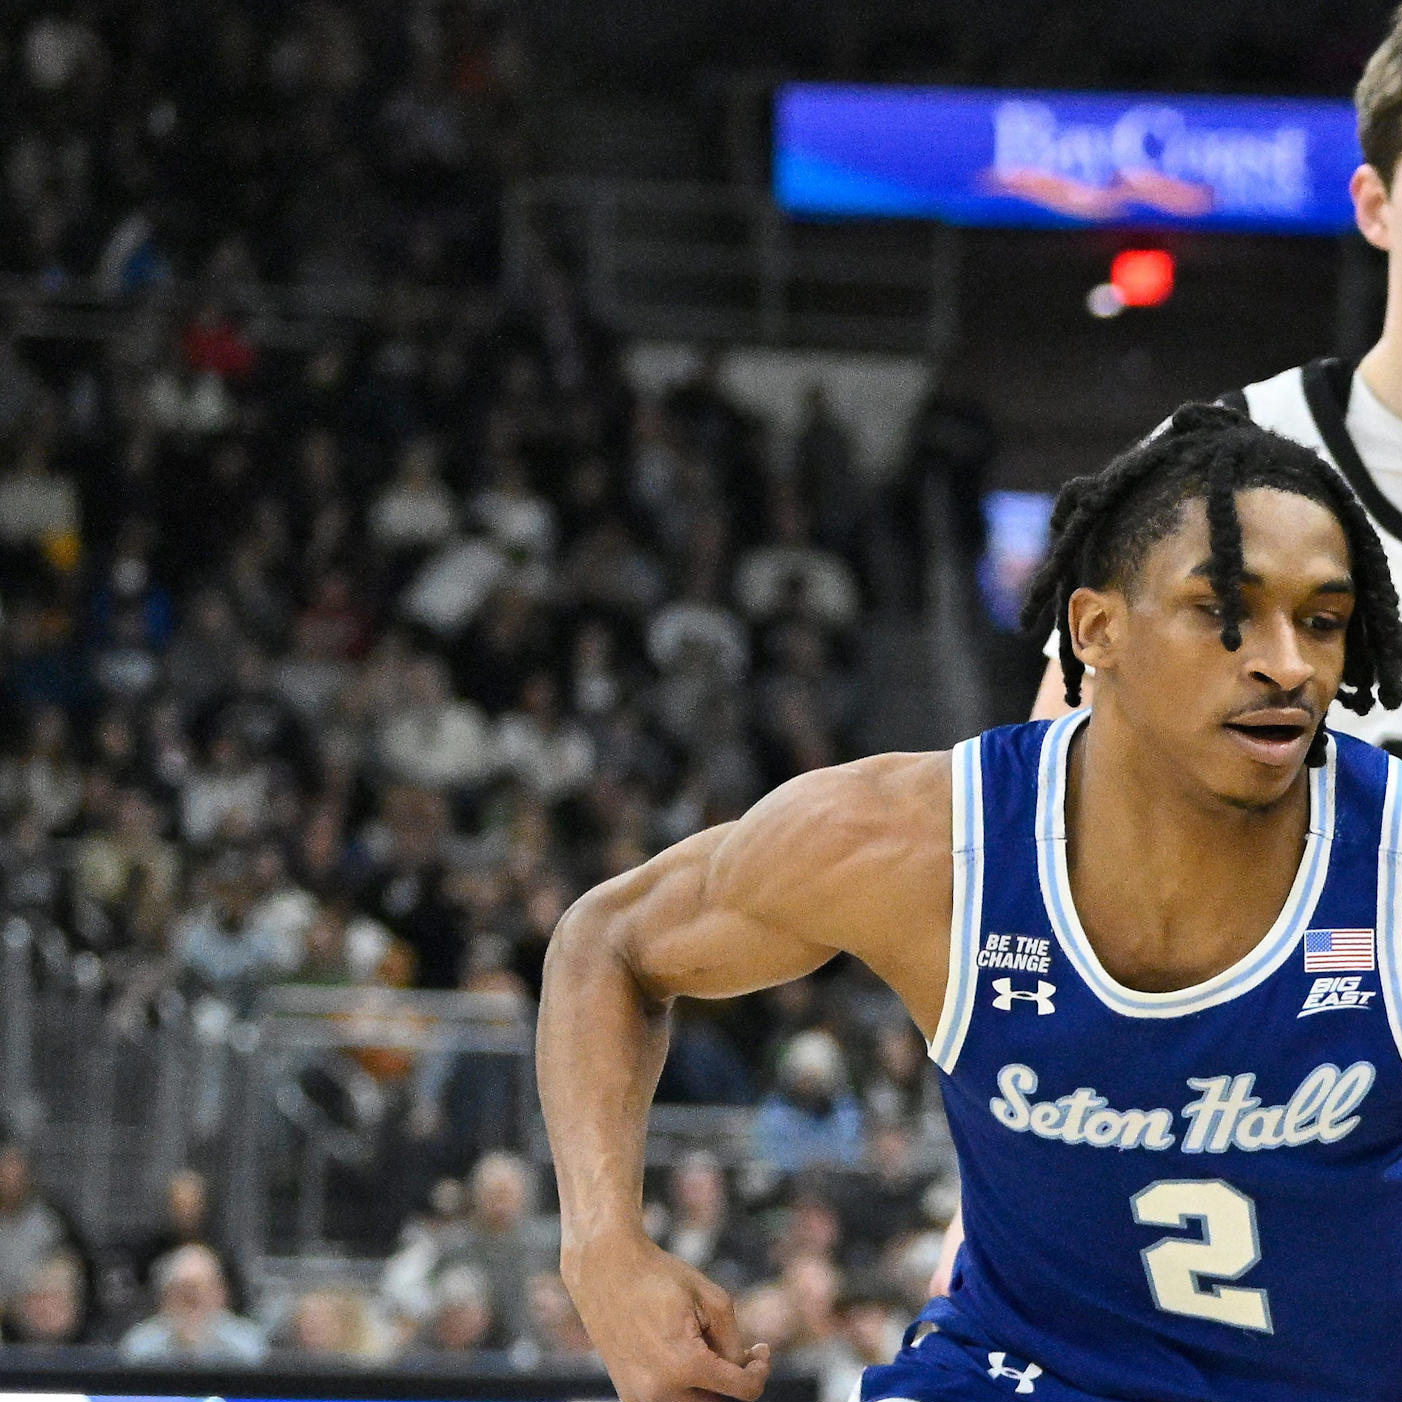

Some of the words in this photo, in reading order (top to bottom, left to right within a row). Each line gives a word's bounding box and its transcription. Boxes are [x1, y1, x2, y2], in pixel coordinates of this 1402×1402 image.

[985, 934, 1012, 951] BE
[1016, 936, 1050, 956] THE
[977, 950, 1051, 973] CHANGE
[1309, 976, 1362, 994] BIG
[1302, 991, 1376, 1009] EAST
[989, 1063, 1175, 1151] Seton
[1181, 1061, 1376, 1153] Hall
[1129, 1178, 1274, 1335] 2
